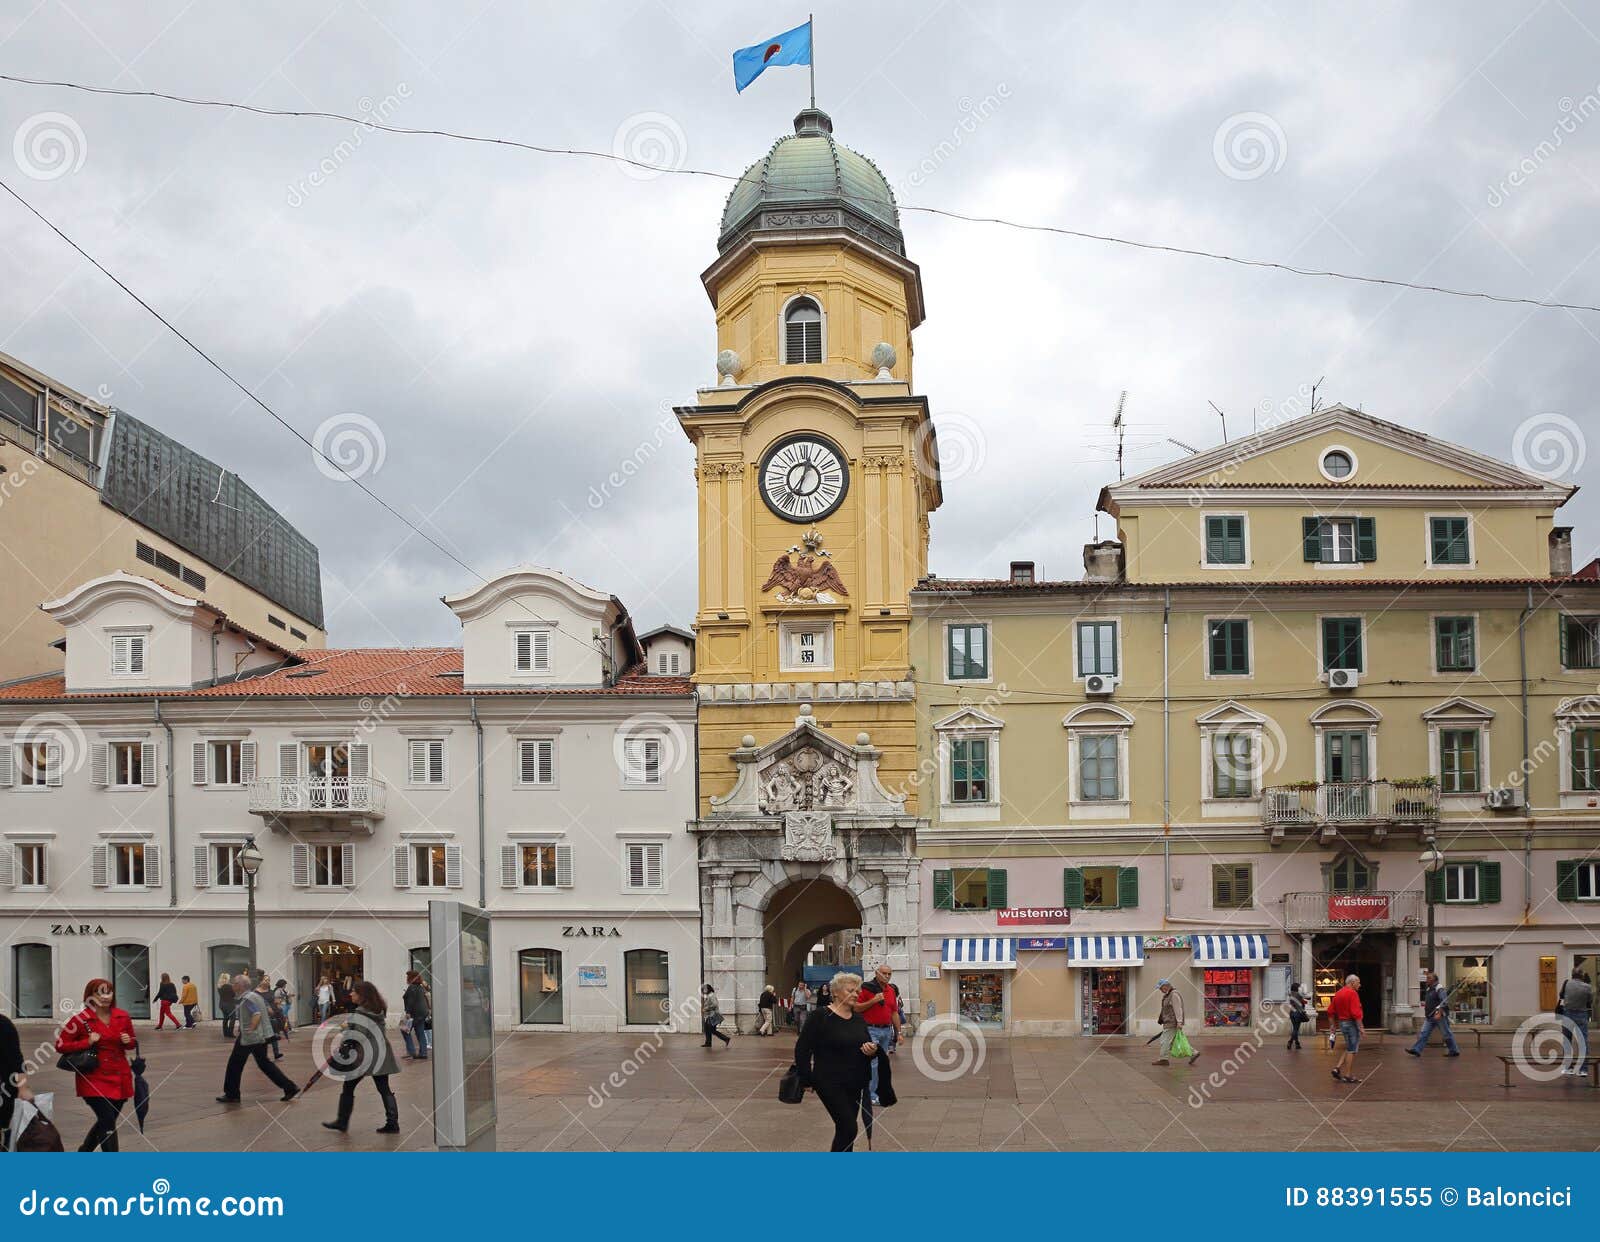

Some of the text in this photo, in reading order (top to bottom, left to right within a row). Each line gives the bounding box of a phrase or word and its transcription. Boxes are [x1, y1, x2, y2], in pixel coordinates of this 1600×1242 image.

[1000, 907, 1068, 918] wüstenrot
[51, 924, 107, 935] ZARA
[563, 926, 622, 937] ZARA
[300, 944, 356, 955] ZARA
